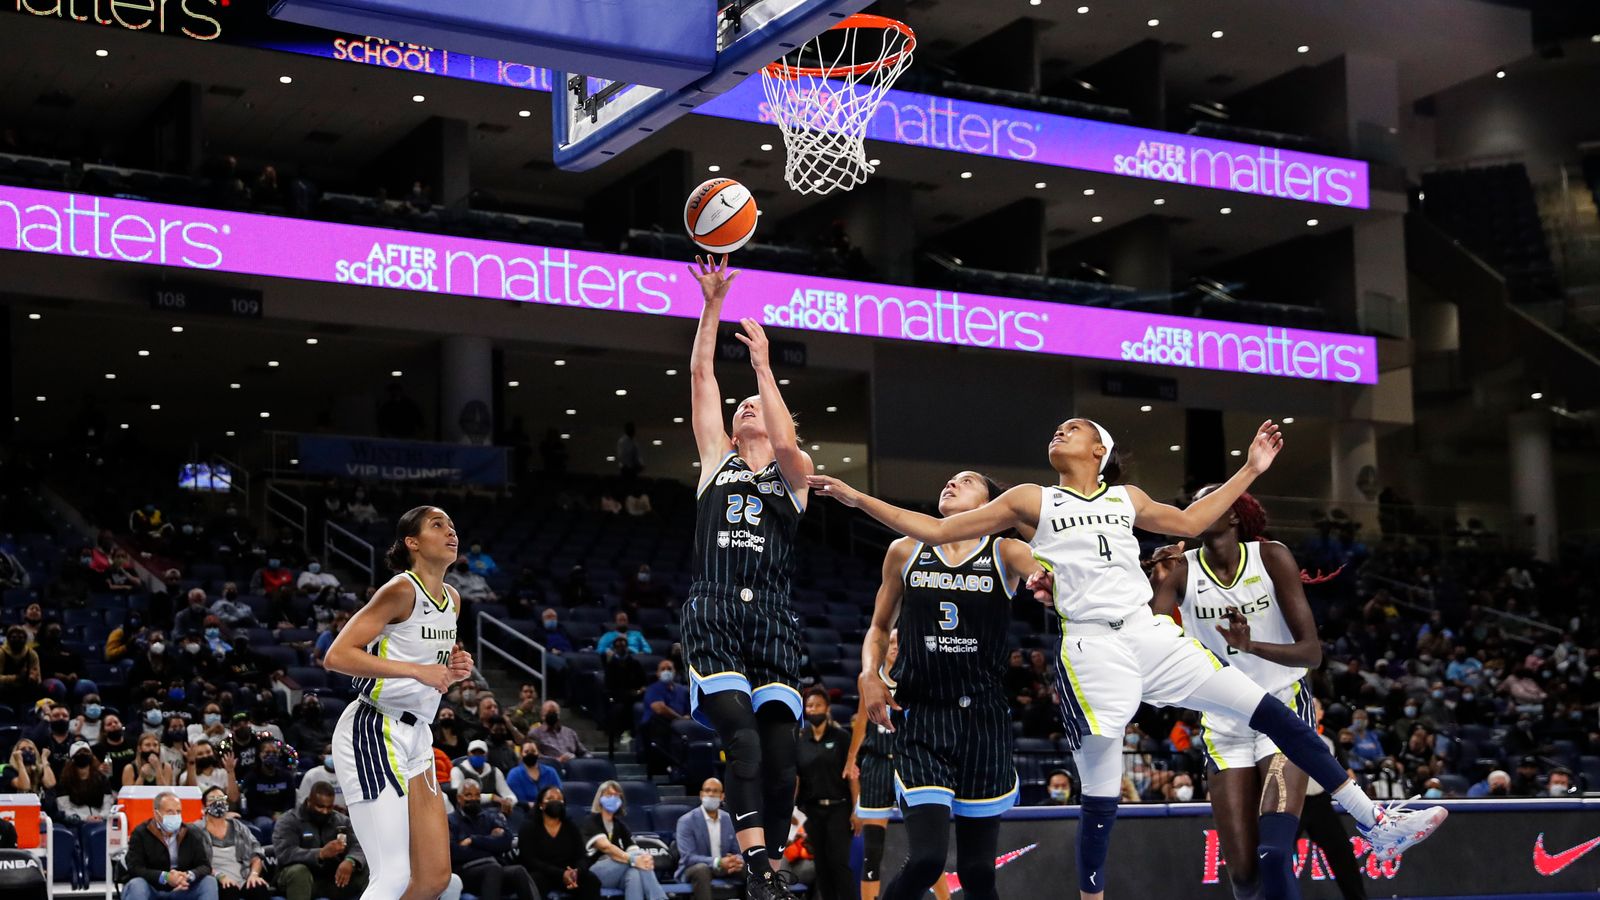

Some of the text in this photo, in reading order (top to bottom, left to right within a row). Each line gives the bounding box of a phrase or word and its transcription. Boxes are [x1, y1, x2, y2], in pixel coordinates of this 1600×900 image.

[333, 38, 436, 73] SCHOOL
[1135, 140, 1186, 163] AFTER
[1113, 154, 1188, 184] SCHOOL
[366, 242, 437, 270] AFTER
[335, 259, 439, 292] SCHOOL
[155, 291, 259, 314] 108 109
[789, 288, 848, 314] AFTER
[762, 304, 850, 333] SCHOOL
[1142, 325, 1194, 348] AFTER
[1120, 340, 1196, 367] SCHOOL
[346, 463, 378, 477] VIP
[715, 469, 784, 497] CHICGO
[726, 494, 763, 526] 22
[1051, 514, 1130, 533] WINGS
[1098, 535, 1112, 561] 4
[910, 571, 994, 593] CHICAGO
[938, 601, 959, 630] 3
[421, 625, 456, 640] WING
[938, 636, 978, 647] UChicago
[939, 645, 978, 653] Medicine
[0, 859, 38, 870] NBA
